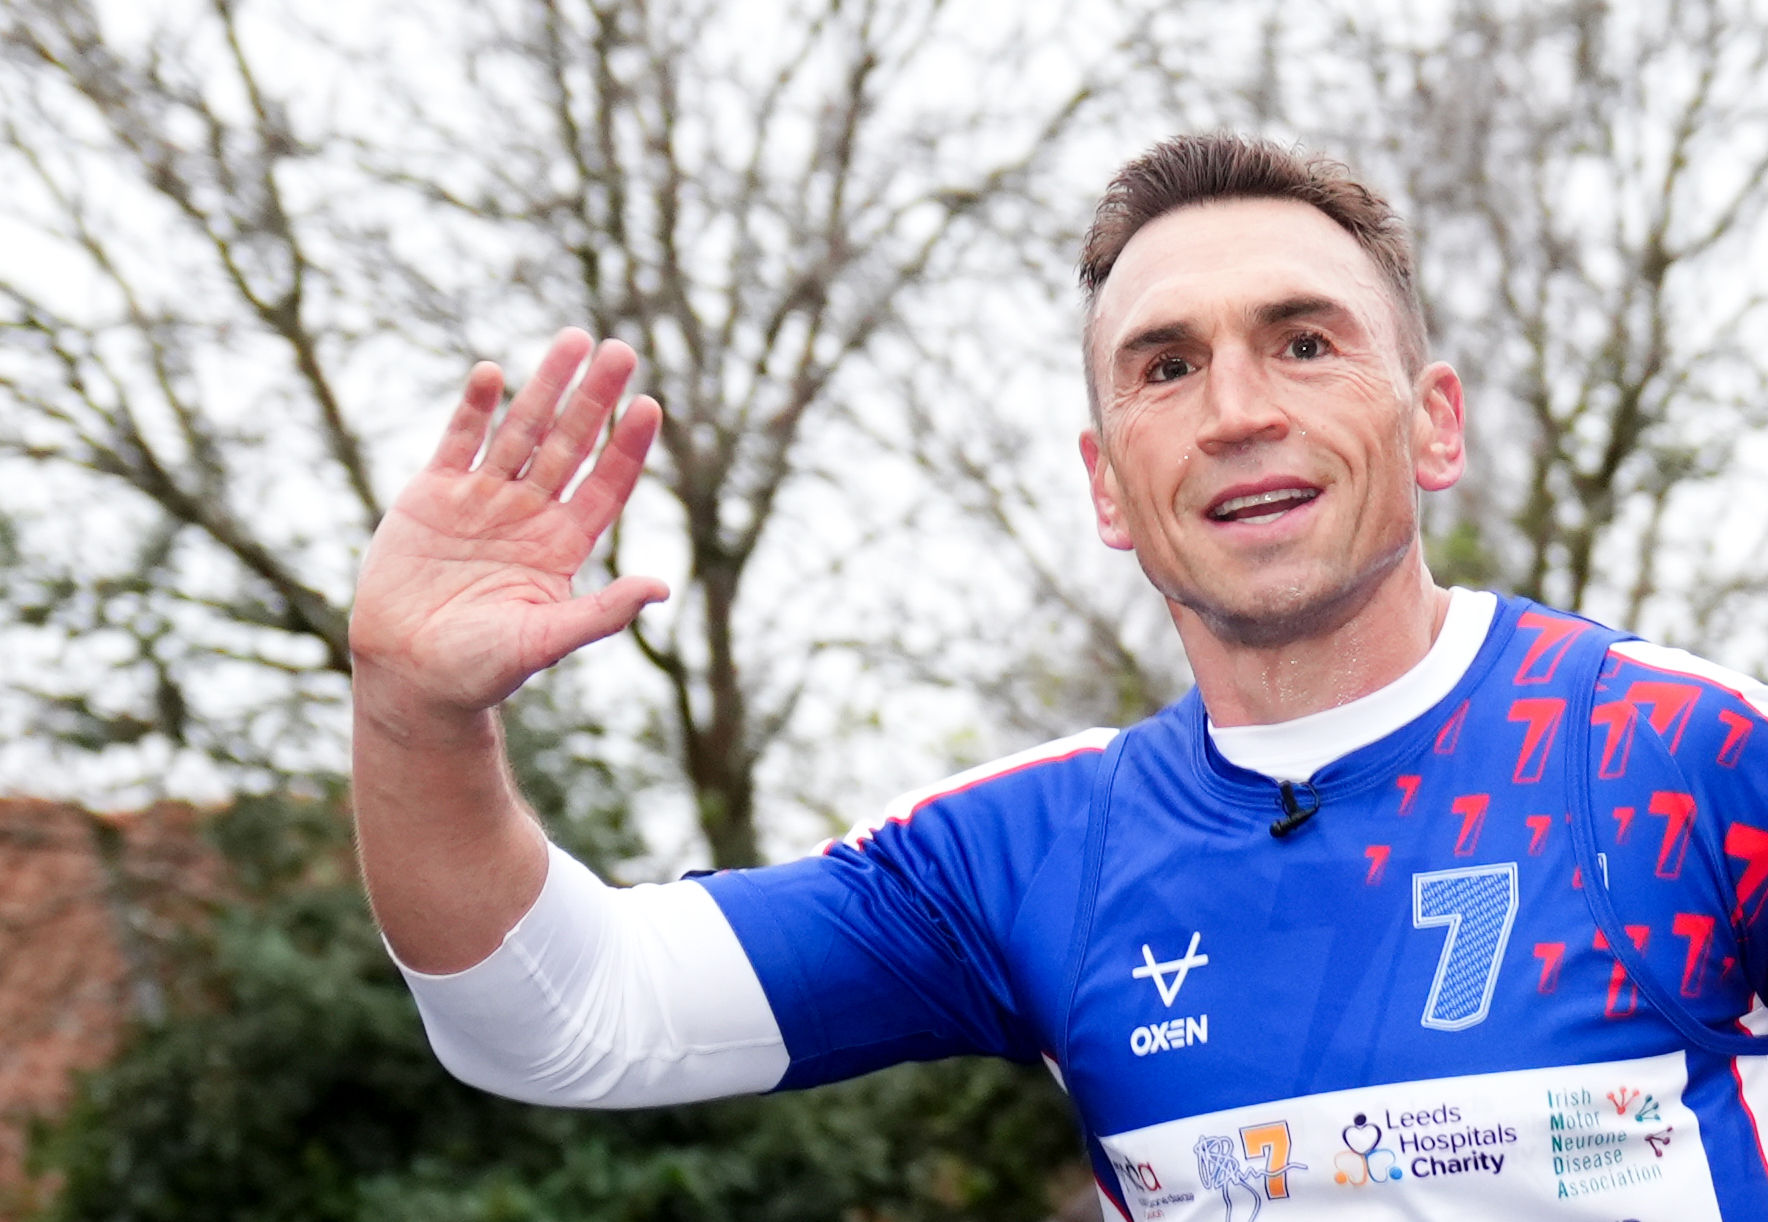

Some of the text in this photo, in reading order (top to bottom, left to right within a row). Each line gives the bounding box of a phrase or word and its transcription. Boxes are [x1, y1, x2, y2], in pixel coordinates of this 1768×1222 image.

[1413, 862, 1519, 1030] 7
[1130, 1015, 1208, 1057] OXEN
[1547, 1087, 1592, 1110] Irish
[1386, 1104, 1462, 1130] Leeds
[1549, 1110, 1600, 1131] Motor
[1400, 1124, 1517, 1155] Hospitals
[1551, 1129, 1627, 1153] Neurone
[1239, 1120, 1291, 1200] 7
[1411, 1150, 1505, 1178] Charity
[1554, 1148, 1624, 1176] Disease
[1557, 1163, 1663, 1199] Association
